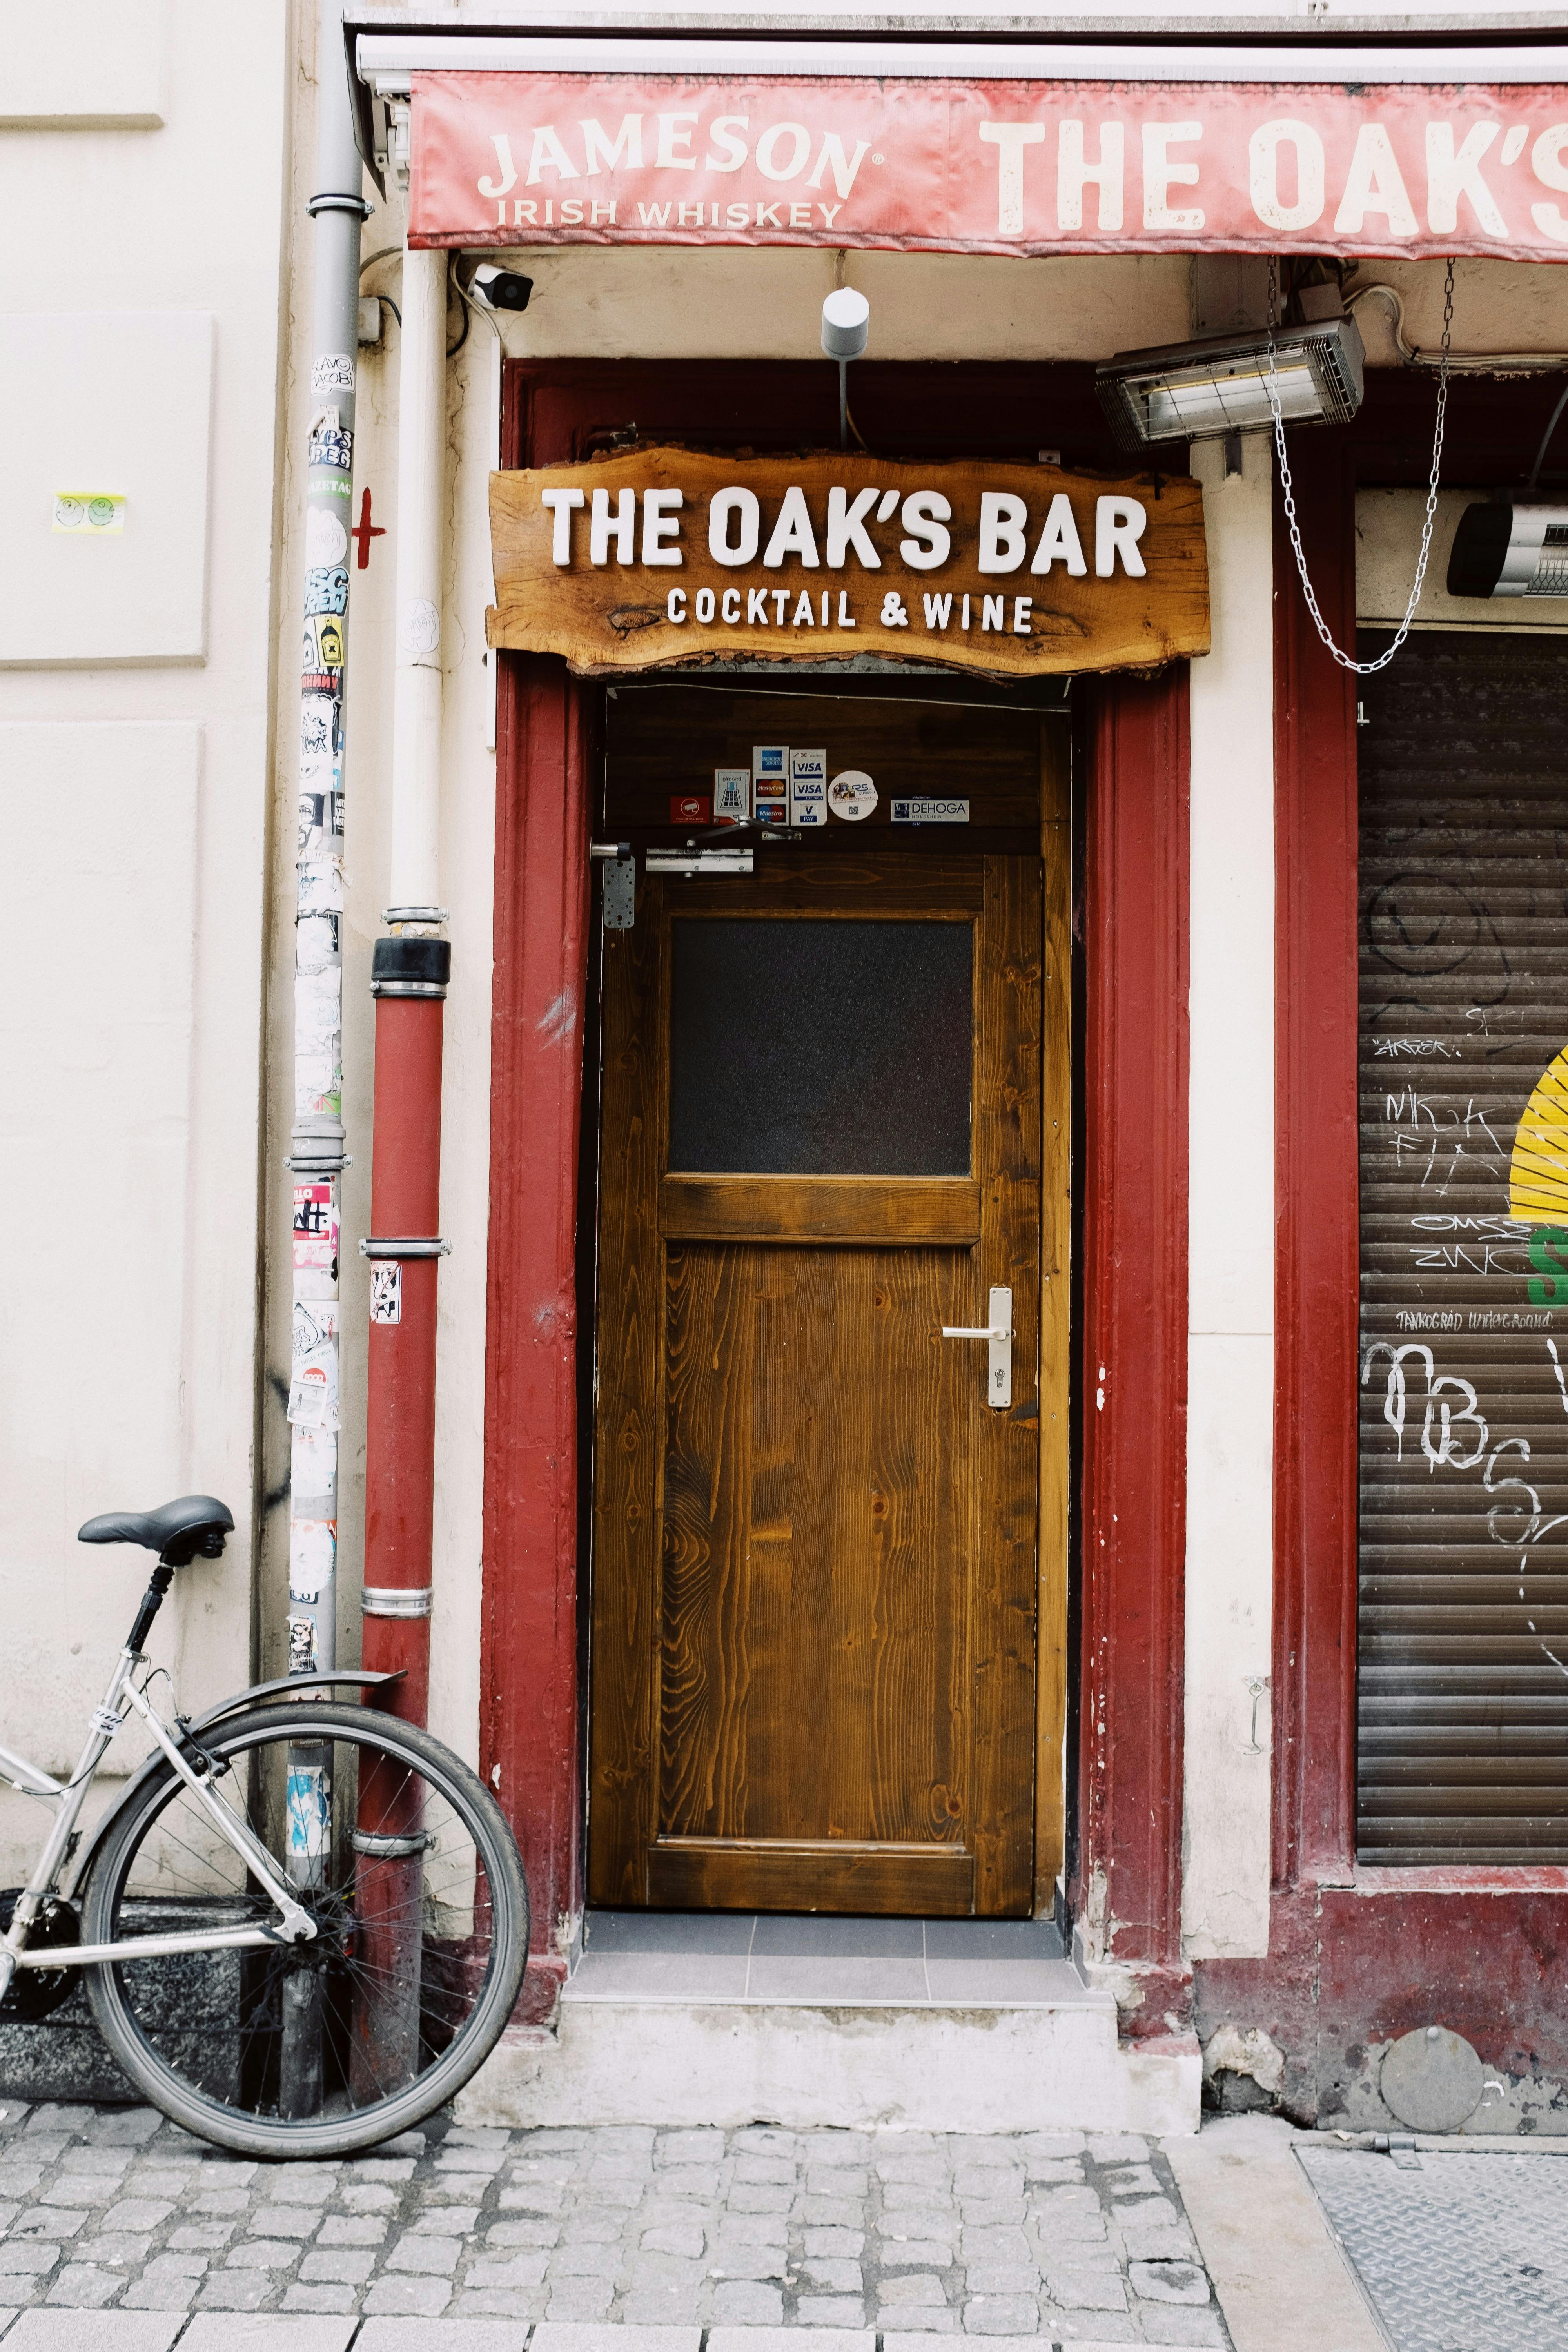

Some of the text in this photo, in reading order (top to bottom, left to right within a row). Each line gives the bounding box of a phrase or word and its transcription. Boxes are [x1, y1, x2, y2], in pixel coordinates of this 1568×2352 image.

[978, 120, 1205, 234] THE
[497, 198, 844, 228] IRISH WHISKEY
[541, 486, 1147, 577] THE OAK'S BAR
[667, 588, 1033, 634] COCKTAIL & WINE
[797, 763, 822, 772] VISA
[796, 785, 822, 794] VISA
[803, 806, 813, 815] V
[912, 803, 966, 814] DEHOGA
